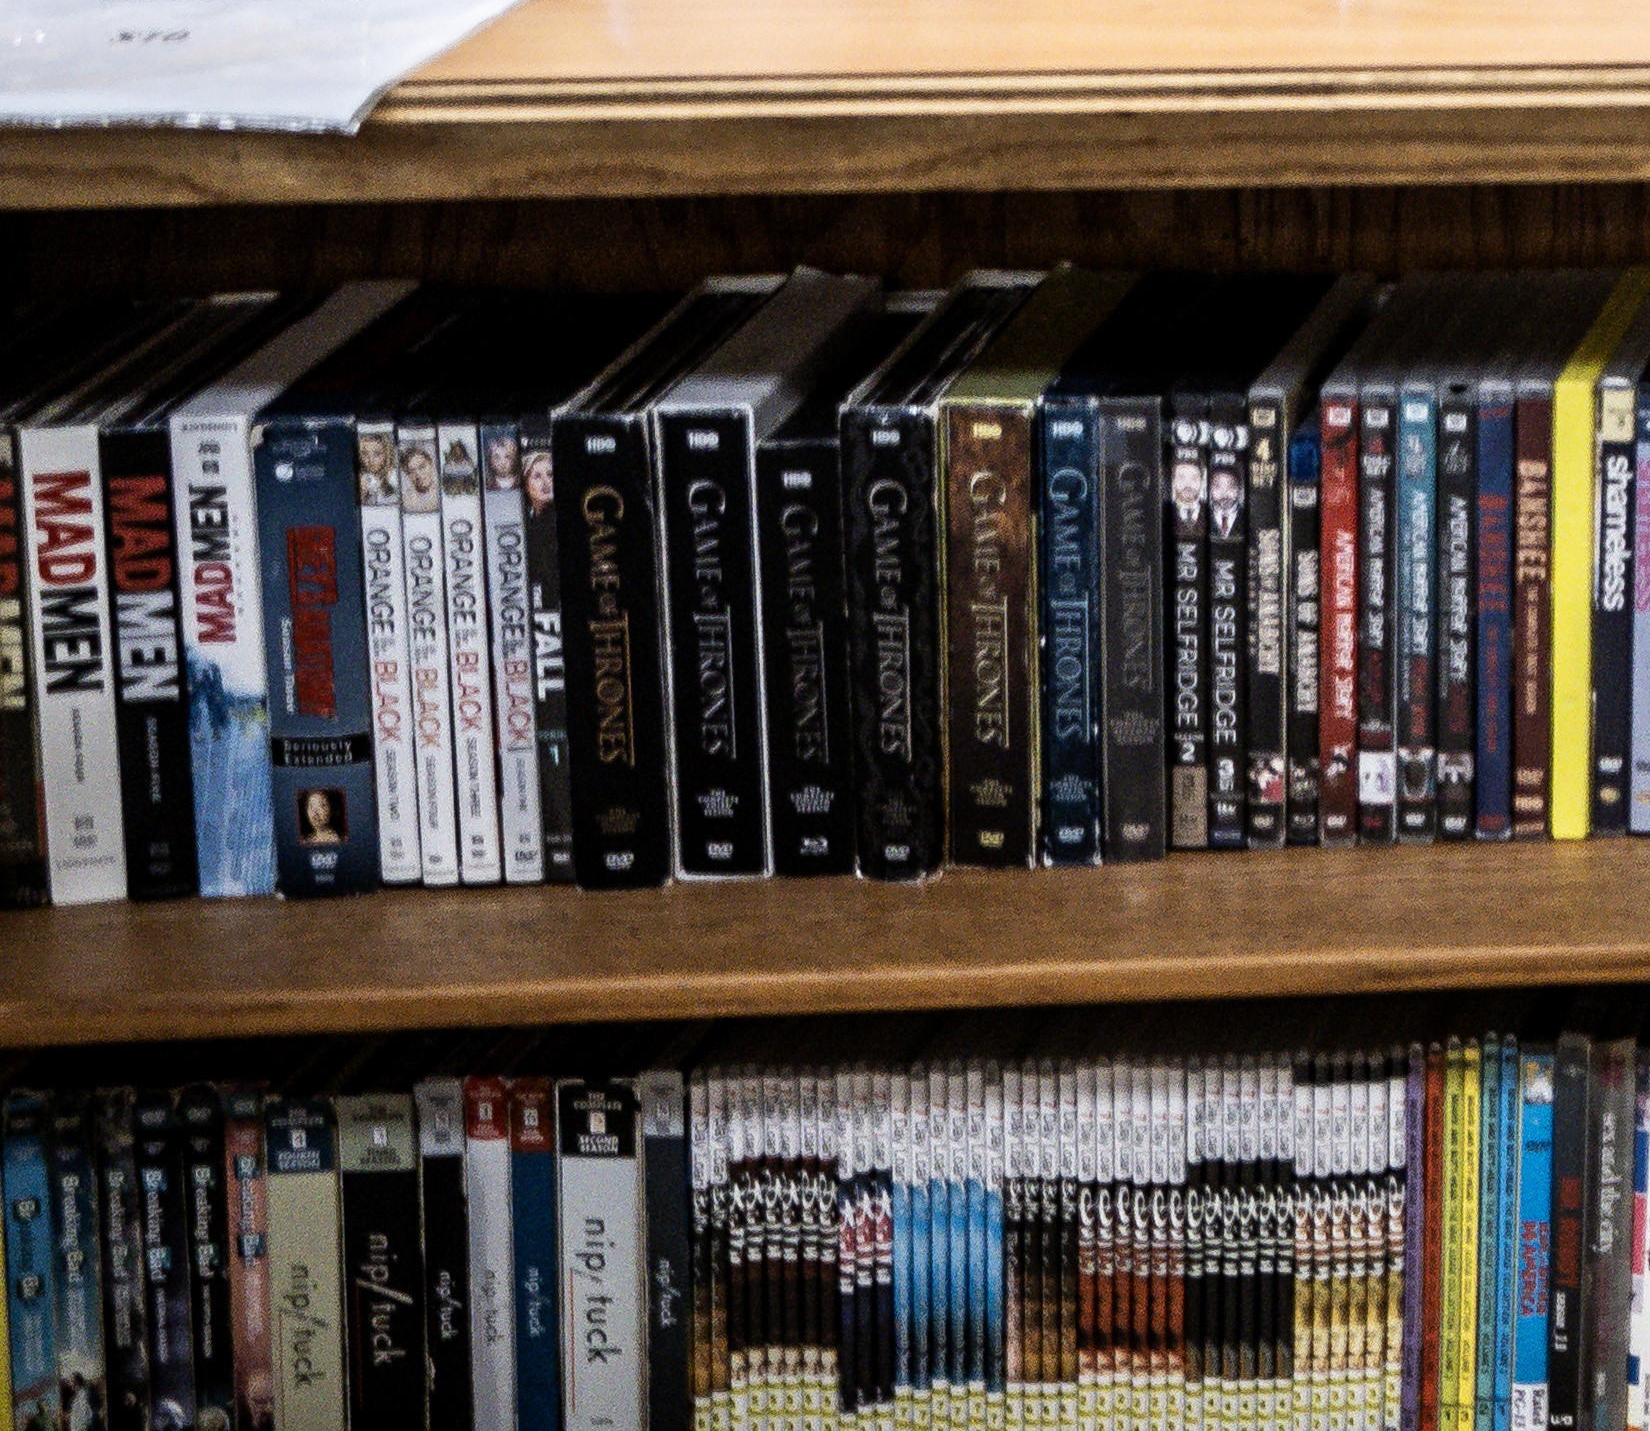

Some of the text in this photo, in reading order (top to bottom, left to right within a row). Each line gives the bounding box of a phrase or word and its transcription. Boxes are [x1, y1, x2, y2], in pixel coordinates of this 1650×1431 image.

[32, 470, 104, 696] MAD MEN
[108, 473, 180, 703] MAD MEN
[188, 484, 237, 644] MAD MEN
[969, 470, 1009, 744] GAME THRONES
[1047, 467, 1090, 742] GAME THRONES
[1479, 494, 1507, 615] BANSHEE
[1517, 460, 1546, 585] BANSHEE
[1601, 455, 1632, 612] shameless
[367, 528, 400, 743] ORANGE BLACK
[409, 537, 440, 746] ORANGE BLACK
[449, 519, 481, 732] ORANGE BLACK
[534, 610, 561, 701] FALL
[582, 485, 628, 764] GAME THRONES
[687, 479, 736, 755] GAME THRONES
[868, 477, 912, 756] GAME THRONES
[1175, 543, 1202, 726] MR SELFRIDGE
[1213, 561, 1238, 744] MR SELFRIDGE
[1592, 1112, 1620, 1255] sex and the city
[283, 1262, 328, 1387] nip/tuck
[357, 1233, 414, 1367] nip/tuck
[435, 1270, 463, 1340] nip/tuck
